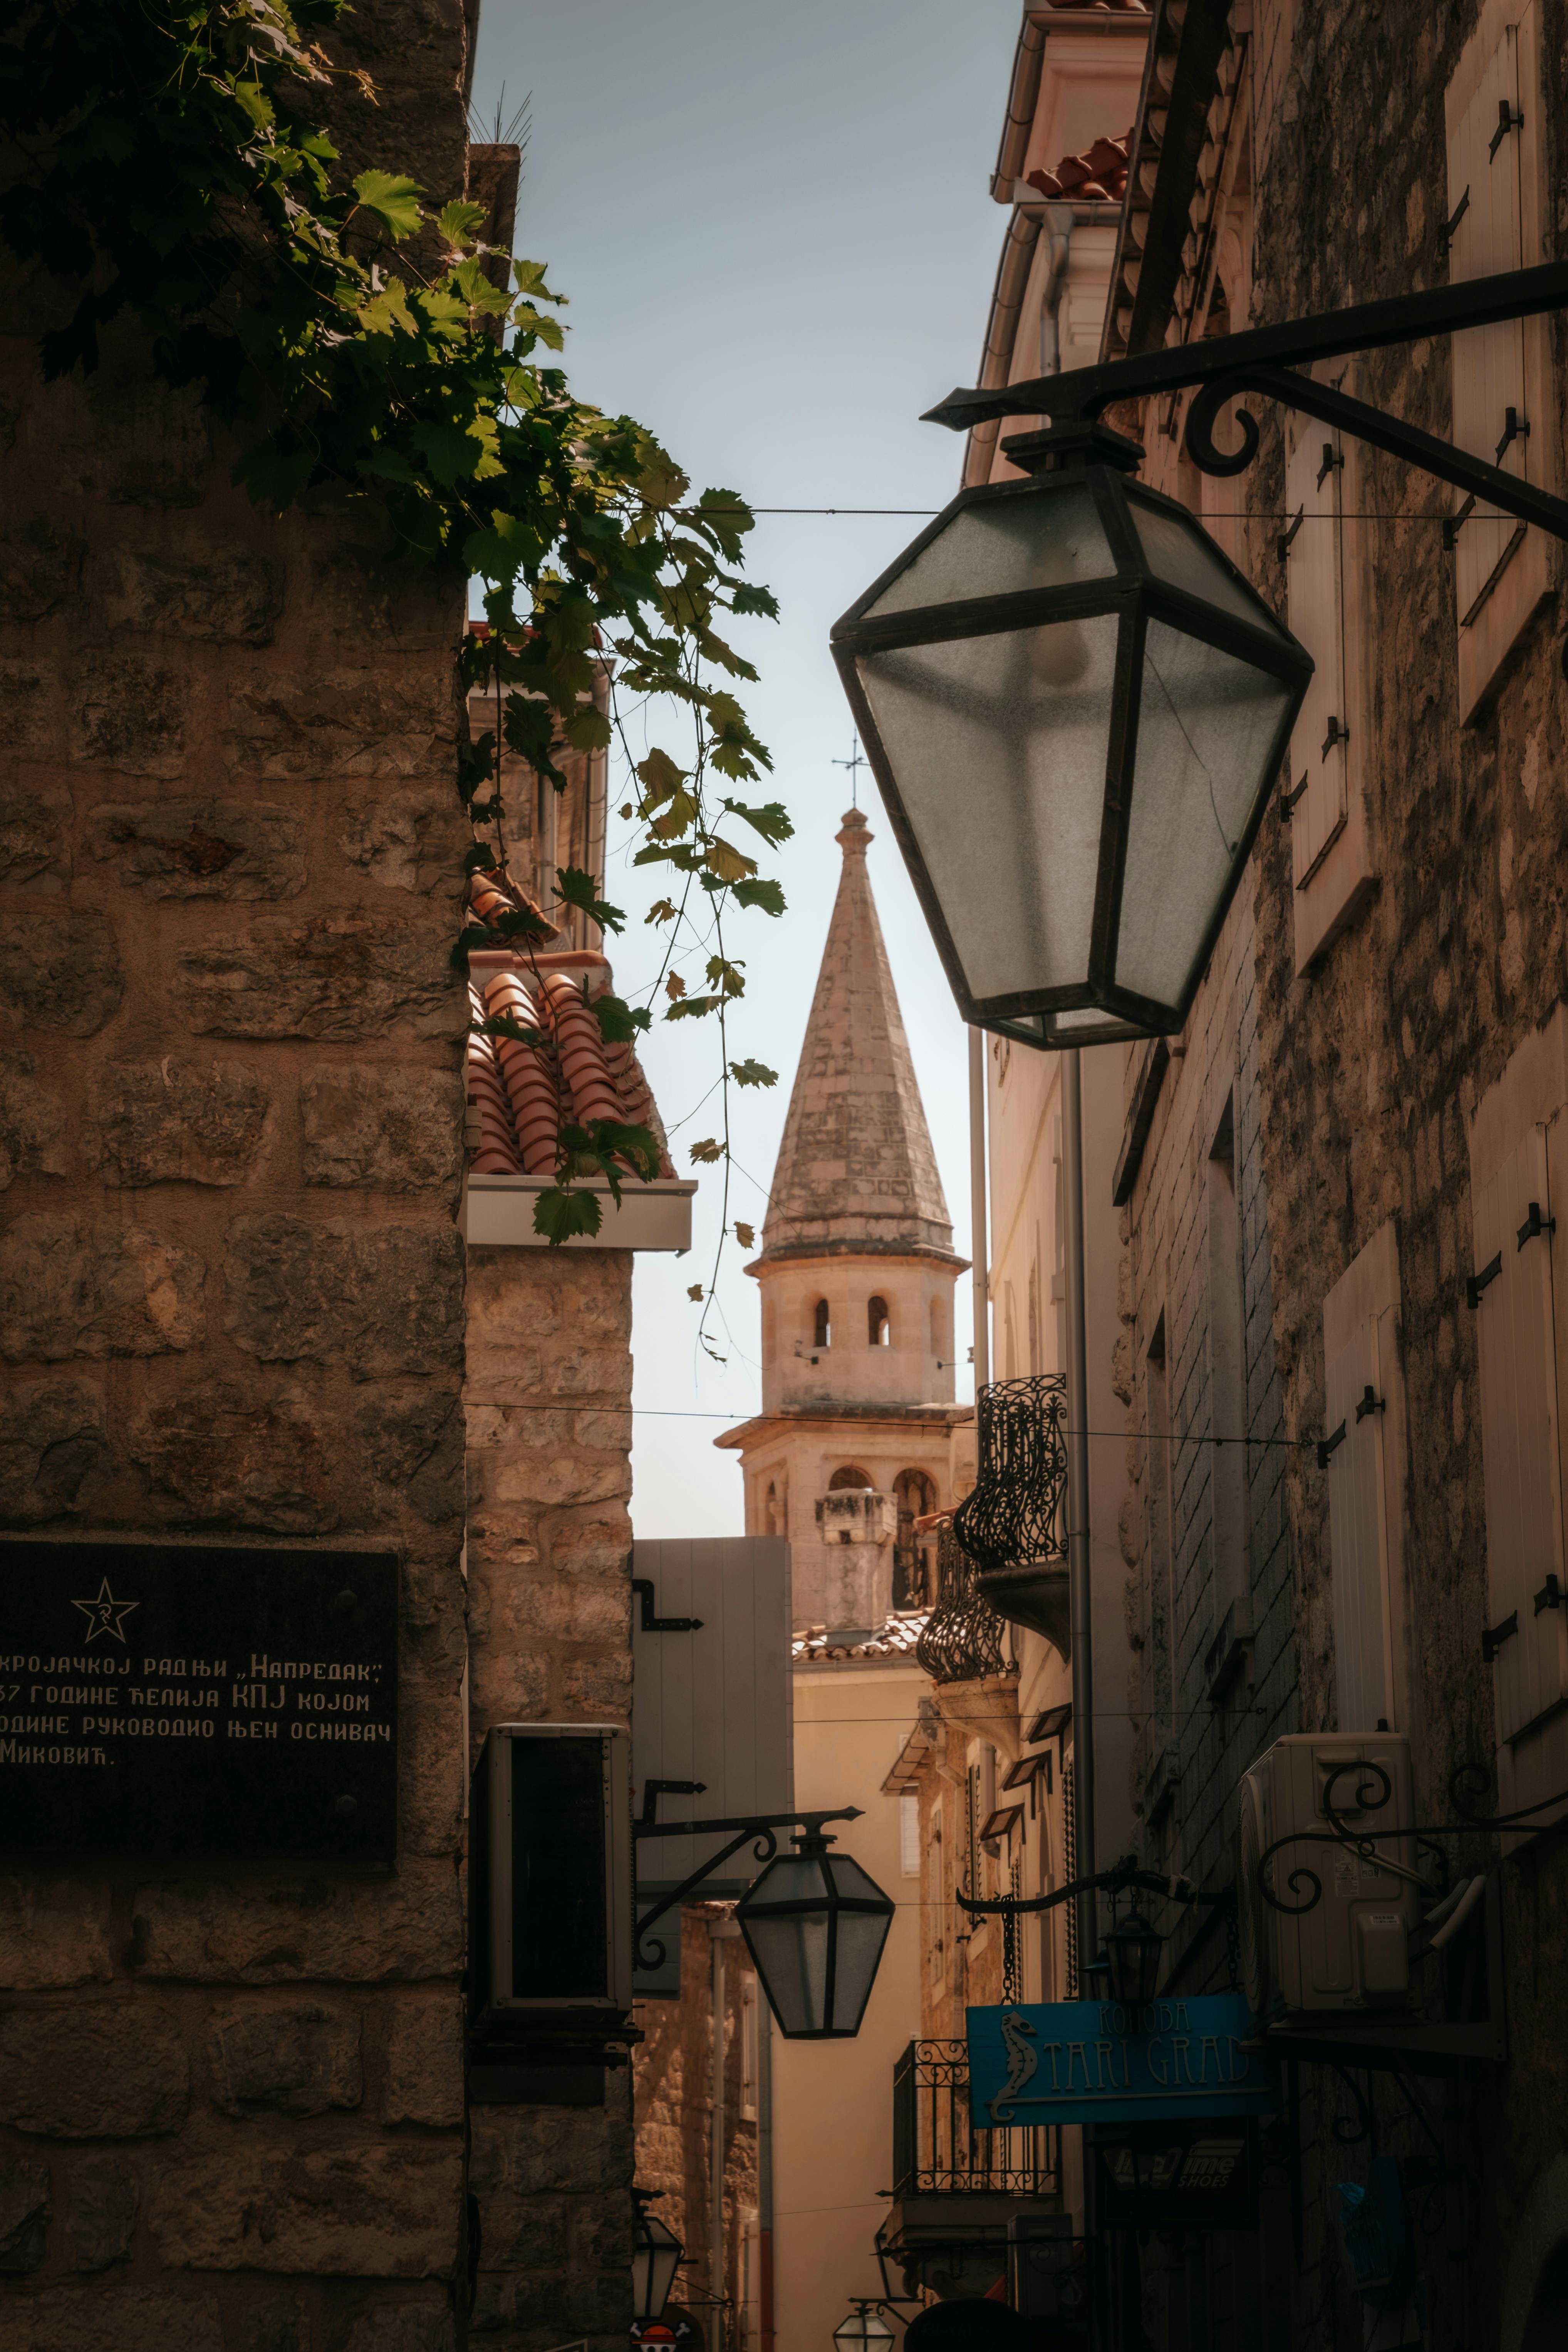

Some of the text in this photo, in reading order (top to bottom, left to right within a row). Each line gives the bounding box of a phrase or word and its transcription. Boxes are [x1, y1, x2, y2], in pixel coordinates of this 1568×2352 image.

[144, 1658, 227, 1677] РАДЊИ
[30, 1686, 118, 1704] ГОДИНЕ
[128, 1688, 218, 1707] ЋЕЛИЈА
[233, 1683, 285, 1708] КПЈ
[298, 1693, 369, 1711] КОЈОМ
[82, 1716, 214, 1737] РУКОВОДИО
[228, 1720, 277, 1738] ЊЕН
[291, 1722, 390, 1741] ОСНИВАЧ
[1146, 2035, 1251, 2086] GRAD
[1177, 2175, 1230, 2188] SHOES
